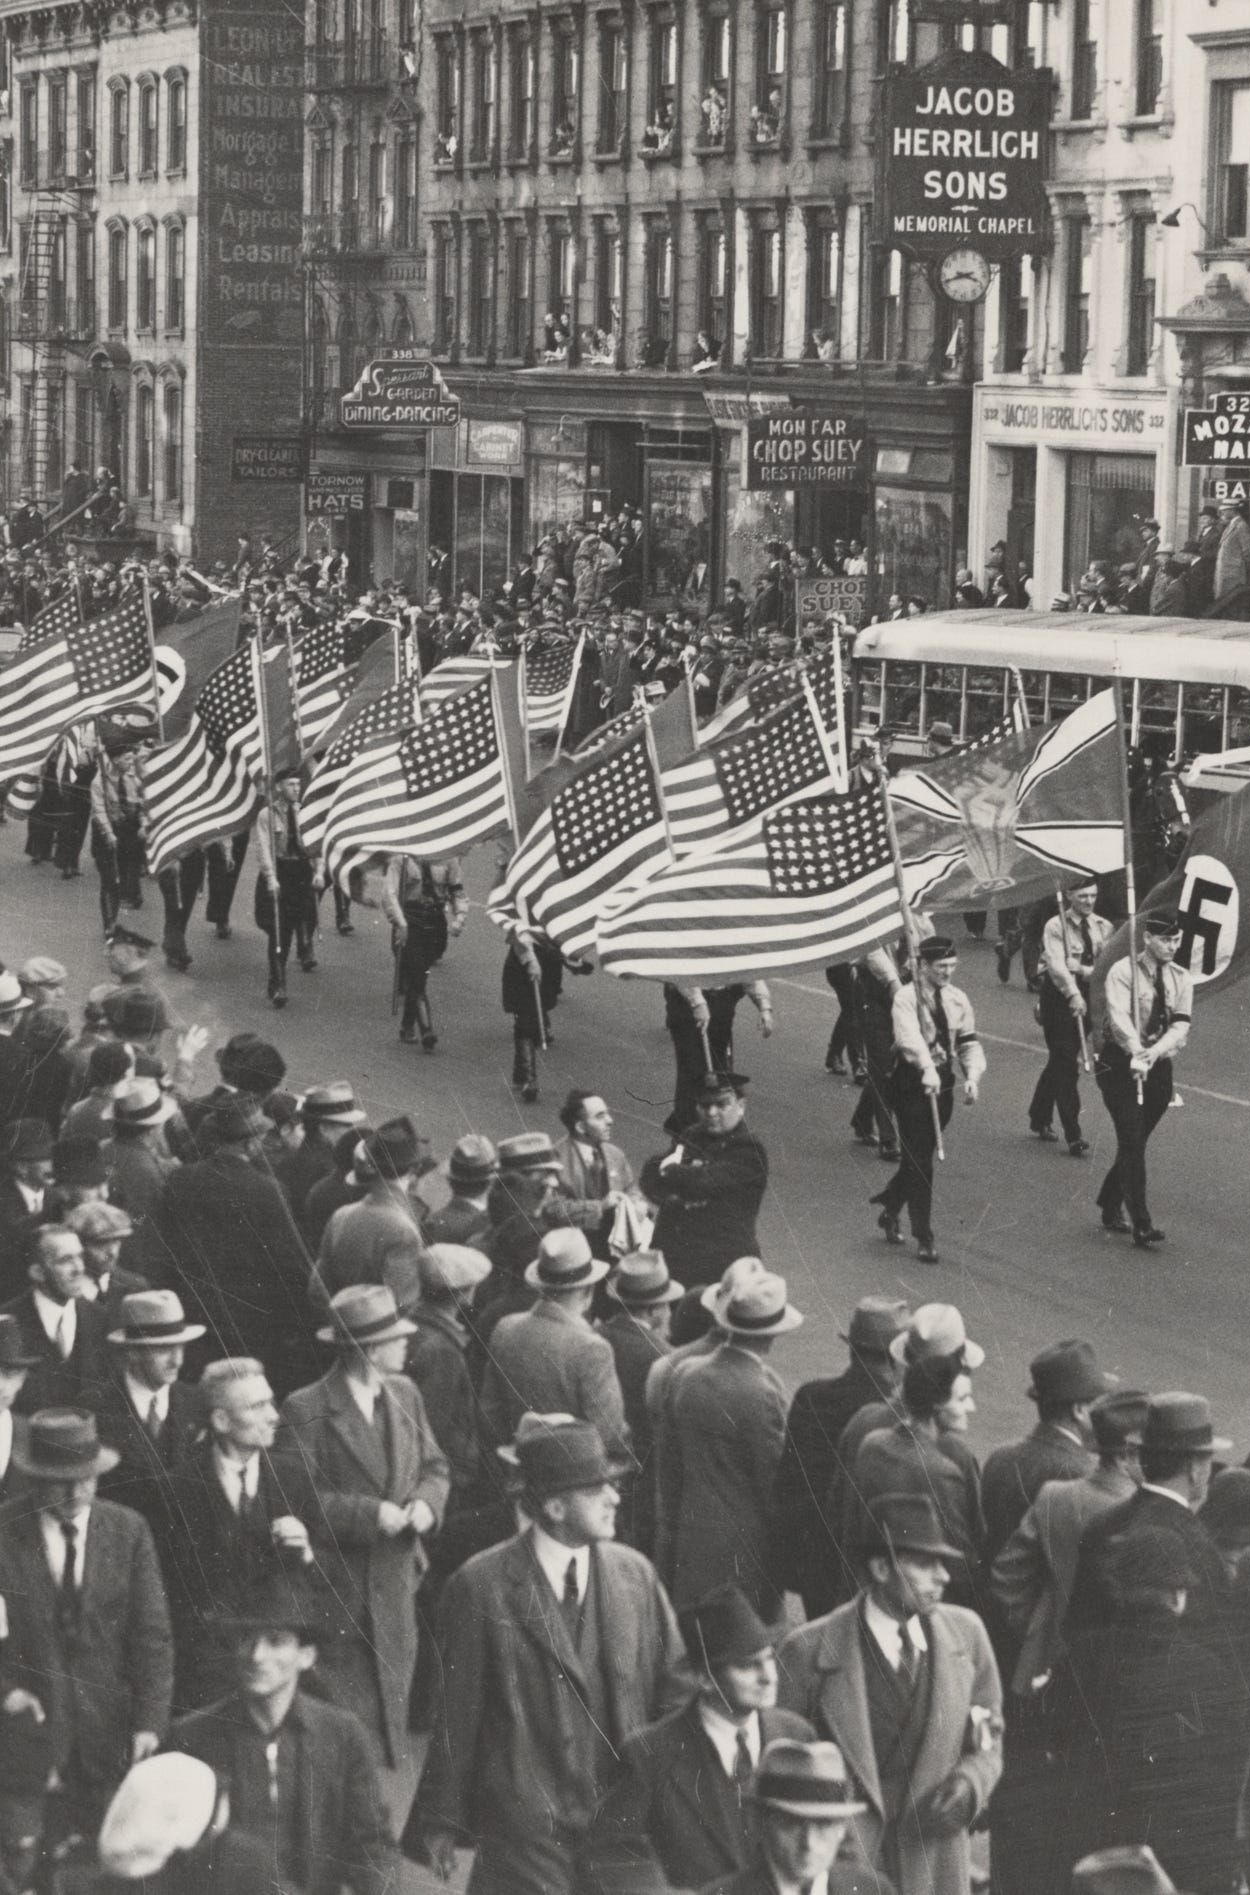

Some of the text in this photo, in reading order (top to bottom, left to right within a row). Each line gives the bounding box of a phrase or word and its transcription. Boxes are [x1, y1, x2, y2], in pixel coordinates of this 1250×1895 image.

[915, 85, 1016, 118] JACOB
[893, 127, 1039, 160] HERRLICH
[923, 170, 1008, 200] SONS
[893, 215, 1036, 234] MEMORIAL CHAPEL
[219, 273, 303, 303] Rentals
[392, 349, 414, 360] 338
[386, 386, 438, 401] GARDEN
[768, 418, 806, 436] MON
[984, 408, 999, 422] 332
[1001, 404, 1039, 429] JACOB
[1112, 408, 1145, 434] SONS
[1148, 415, 1165, 428] 332
[753, 438, 863, 464] CHOP SUEY
[238, 466, 298, 478] TAILORS
[309, 475, 365, 486] TORNOW
[760, 465, 857, 482] RESTAURANT
[308, 494, 364, 511] HATS
